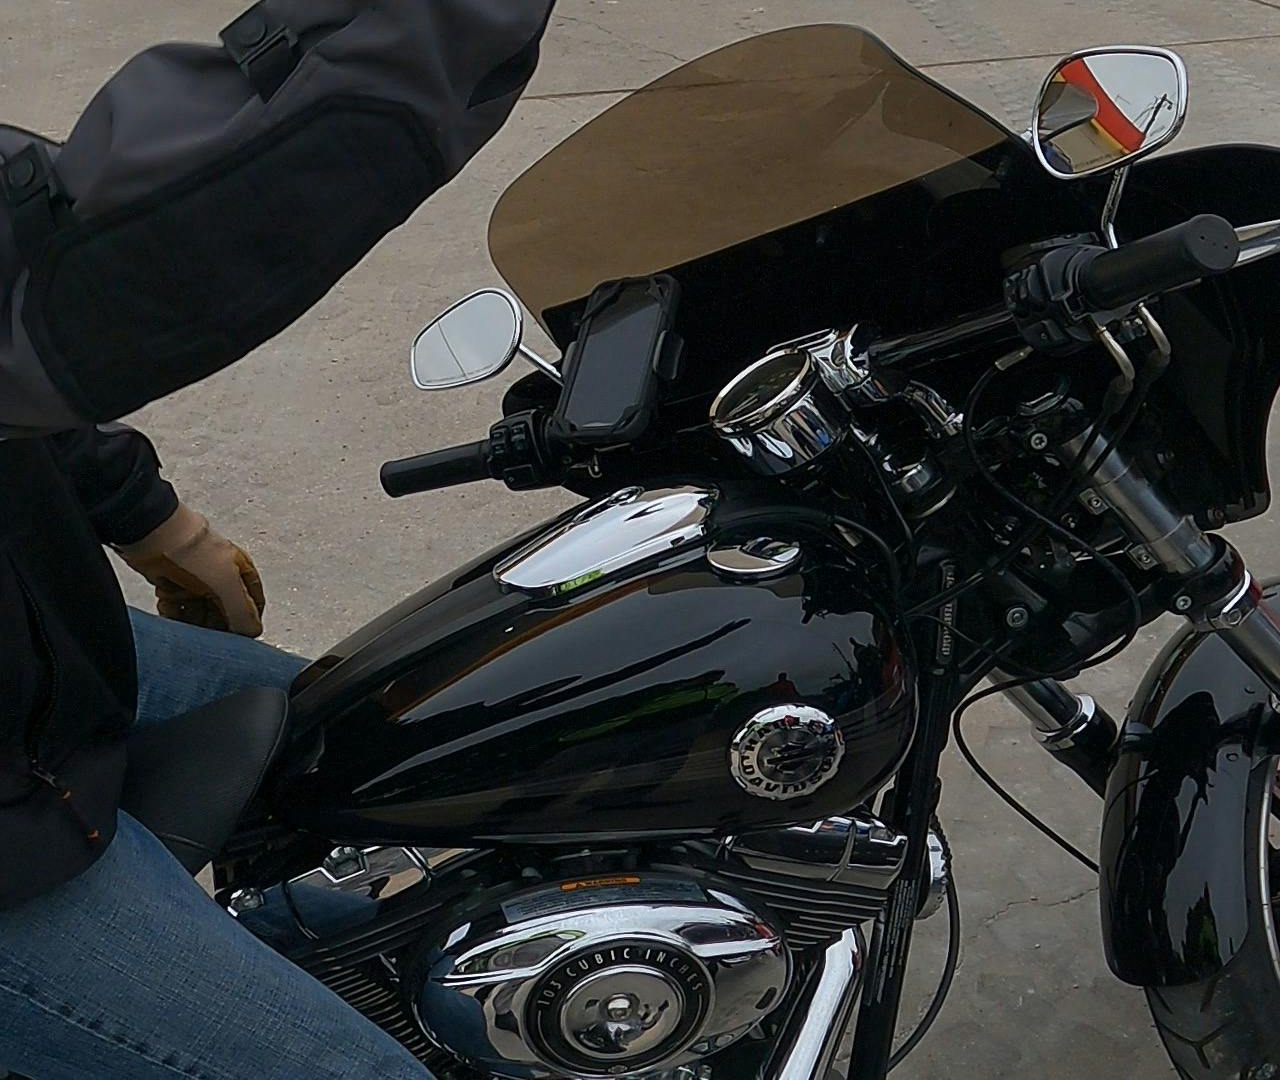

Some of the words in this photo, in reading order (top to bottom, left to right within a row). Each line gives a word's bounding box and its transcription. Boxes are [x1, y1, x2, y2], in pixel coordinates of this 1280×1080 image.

[537, 980, 562, 1006] 103
[566, 947, 631, 978] CUBIC
[645, 948, 704, 992] INCHES
